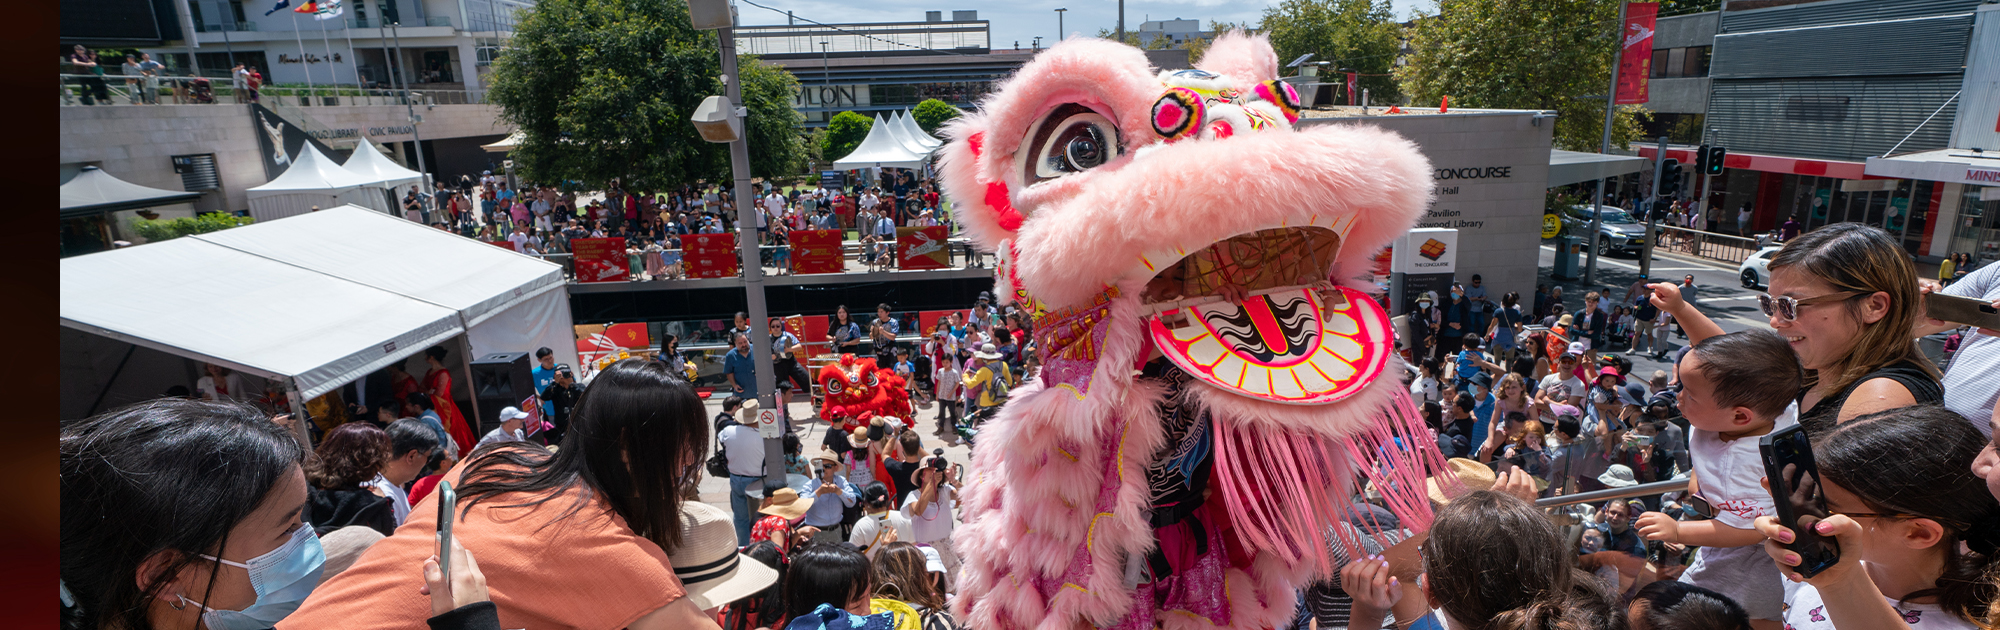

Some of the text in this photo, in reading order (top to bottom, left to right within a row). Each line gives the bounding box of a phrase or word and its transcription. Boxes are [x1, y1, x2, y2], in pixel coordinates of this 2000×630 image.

[330, 128, 359, 138] LIBRARY
[369, 126, 414, 136] CIVIC PAVILION
[1434, 166, 1511, 180] CONCOURSE
[1442, 186, 1459, 195] Hall
[1427, 209, 1461, 218] Pavilion
[1453, 219, 1483, 229] Library
